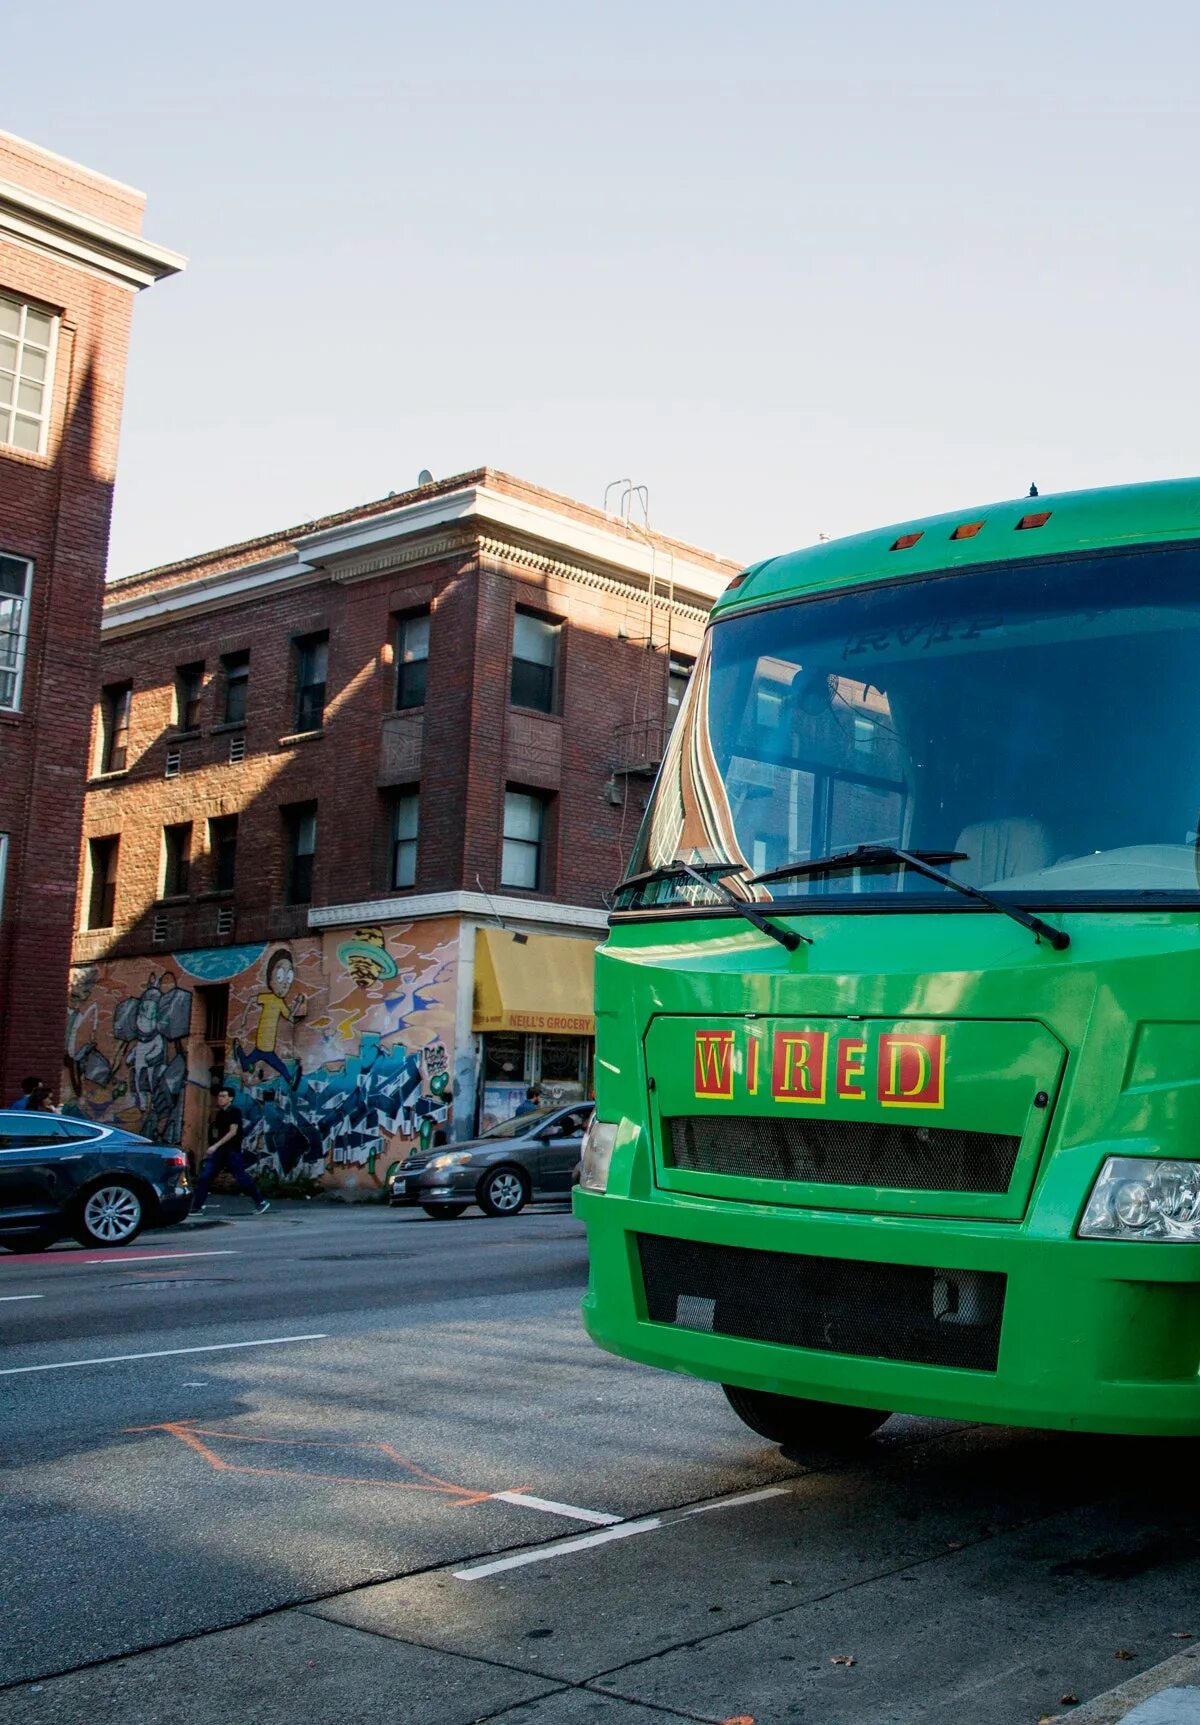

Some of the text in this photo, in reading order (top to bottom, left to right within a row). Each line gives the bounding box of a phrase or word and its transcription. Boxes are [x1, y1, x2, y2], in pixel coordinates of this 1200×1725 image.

[510, 1014, 545, 1028] NEILL'S
[546, 1016, 591, 1031] GROCERY
[694, 1029, 947, 1110] WIRED
